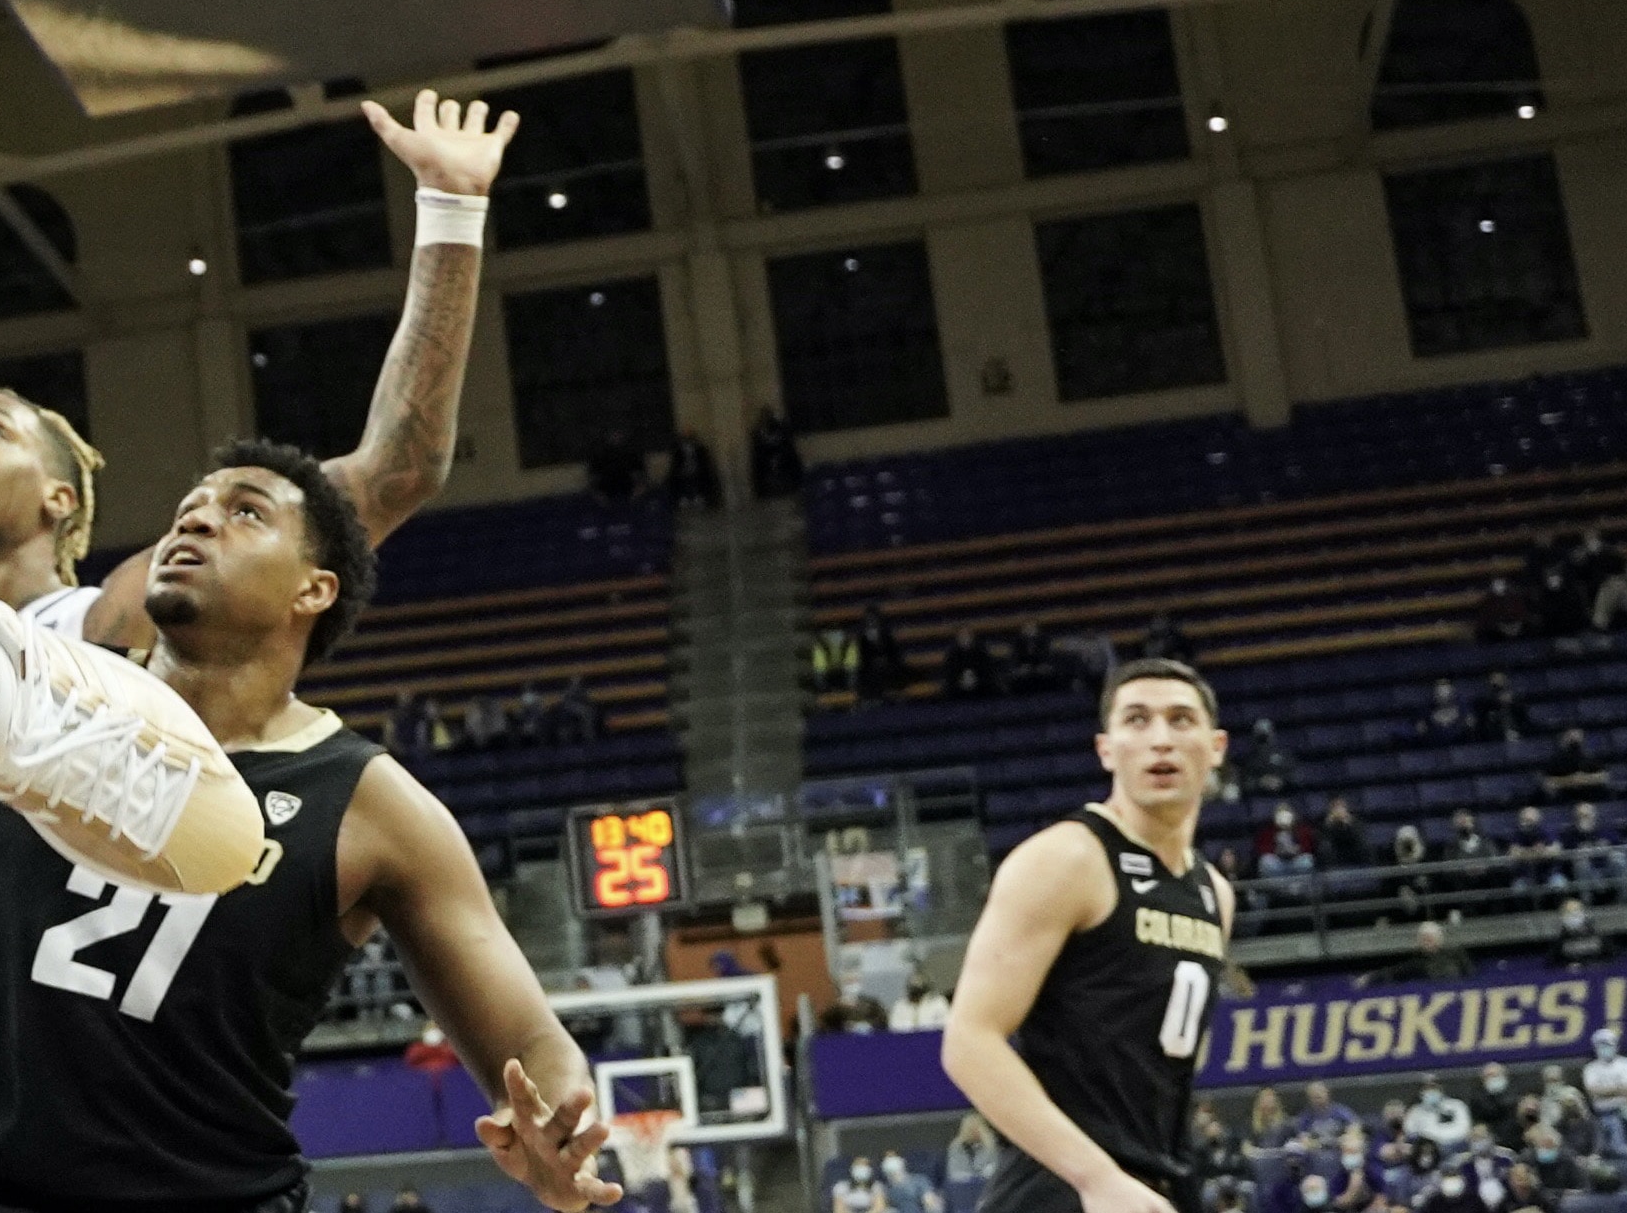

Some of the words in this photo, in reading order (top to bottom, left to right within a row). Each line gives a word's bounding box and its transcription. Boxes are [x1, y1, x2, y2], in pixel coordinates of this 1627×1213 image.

[593, 844, 669, 906] 25
[31, 864, 219, 1023] 21
[1159, 960, 1211, 1057] 0
